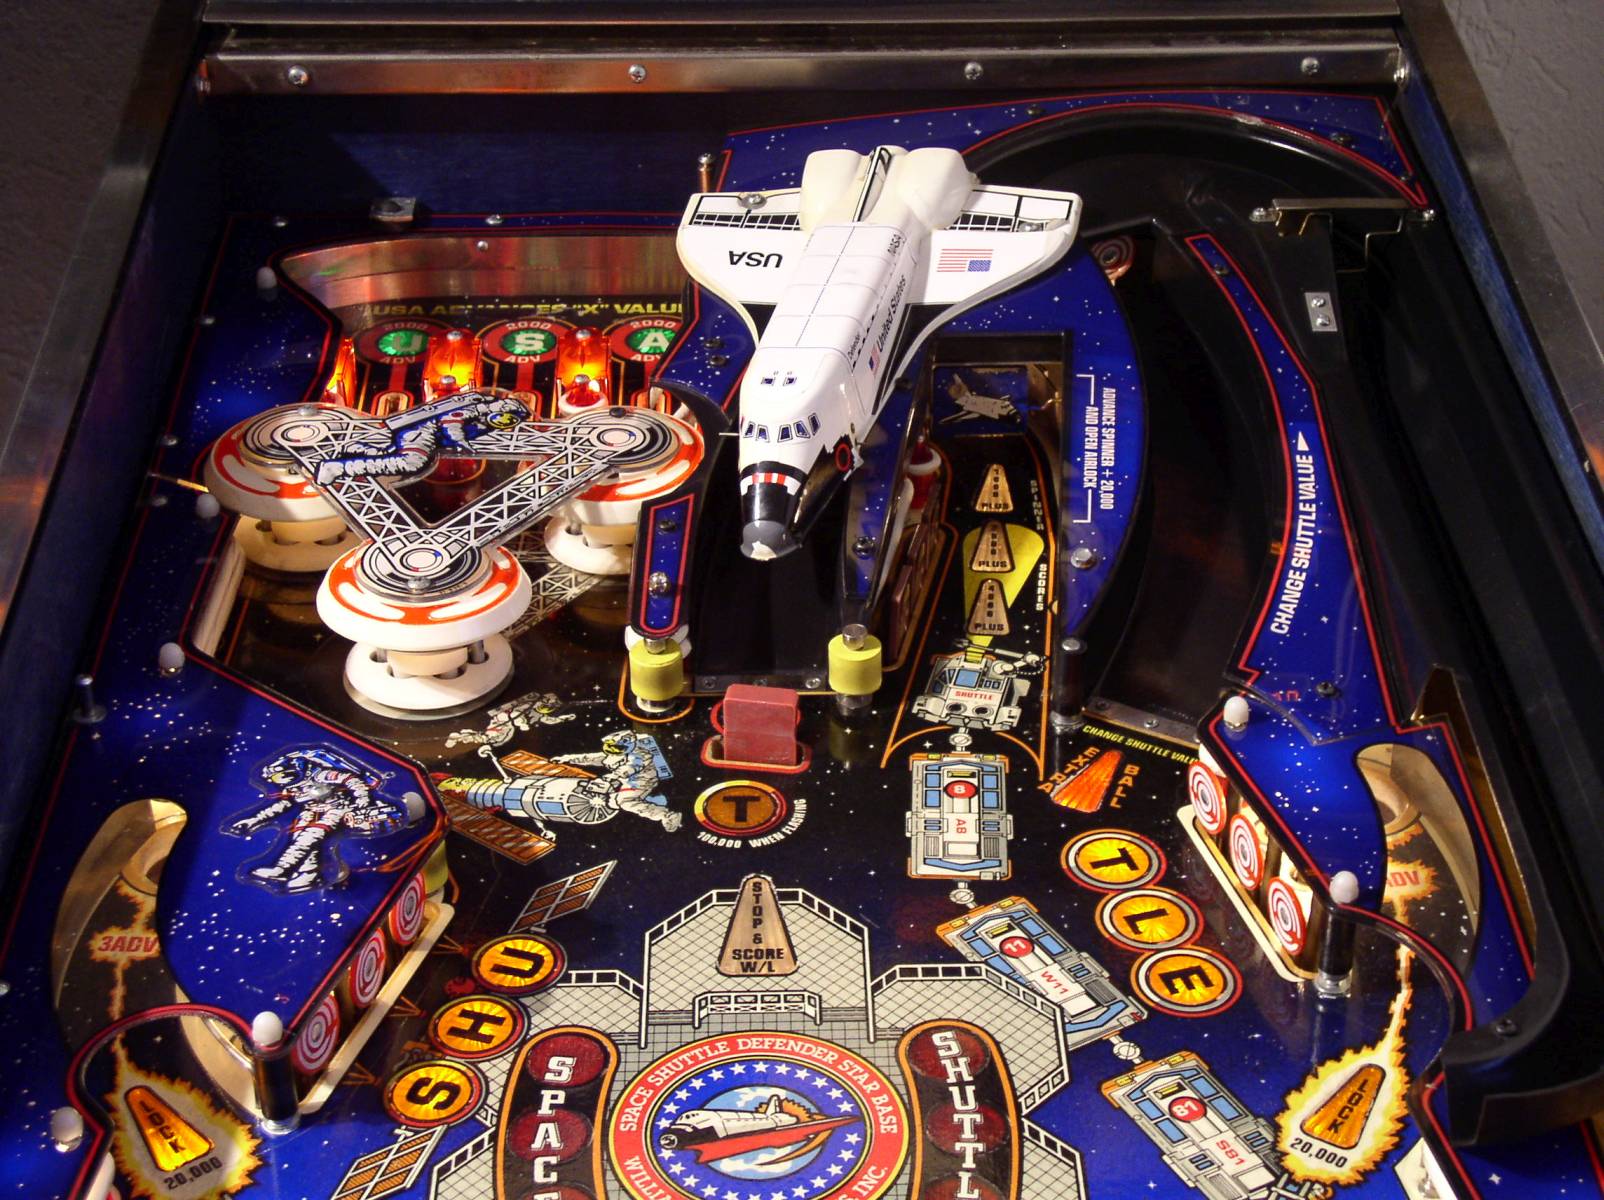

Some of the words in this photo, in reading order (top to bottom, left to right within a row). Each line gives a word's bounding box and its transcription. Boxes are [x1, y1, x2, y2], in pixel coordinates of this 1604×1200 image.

[728, 250, 783, 268] USA
[374, 305, 425, 316] USA
[629, 319, 677, 328] 2000
[505, 320, 552, 330] 2000
[877, 308, 894, 353] United
[392, 334, 423, 352] U
[514, 333, 546, 352] S
[638, 332, 671, 352] A
[379, 356, 417, 365] ADV
[503, 354, 542, 364] ADV
[1085, 406, 1099, 425] AND
[1102, 387, 1116, 426] ADVANCE
[1084, 426, 1098, 450] OPEN
[1101, 427, 1115, 467] SPINNER
[1083, 451, 1098, 488] AIRLOCK
[1296, 454, 1317, 502] VALUE
[981, 502, 1009, 510] PLUS
[1099, 479, 1114, 510] 20,000
[1291, 502, 1316, 569] SHUTTLE
[978, 560, 1008, 569] PLUS
[1270, 569, 1307, 635] CHANGE
[974, 623, 1005, 632] PLUS
[954, 690, 994, 701] SHUTTLE
[1082, 725, 1126, 745] CHANGE
[1125, 738, 1170, 758] SHUTTLE
[1037, 746, 1100, 794] EXTRA
[1109, 764, 1140, 809] BALL
[722, 795, 761, 823] T
[697, 830, 742, 849] 100,000
[749, 831, 786, 849] WHEN
[782, 798, 807, 835] FLASHING
[1089, 847, 1139, 872] T
[751, 881, 764, 930] STOP
[1122, 907, 1169, 936] L
[98, 935, 158, 953] 3ADV
[752, 932, 764, 945] &
[1004, 939, 1027, 953] 11
[489, 946, 545, 979] U
[732, 947, 785, 961] SCORE
[740, 960, 776, 974] W/L
[1041, 970, 1069, 995] W11
[1158, 964, 1215, 996] E
[446, 1008, 506, 1045] H
[406, 1076, 462, 1111] S
[619, 1086, 655, 1132] SPACE
[647, 1041, 731, 1087] SHUTTLE
[737, 1037, 839, 1065] DEFENDER
[837, 1059, 881, 1095] STAR
[871, 1093, 898, 1134] BASE
[1171, 1100, 1199, 1117] 81
[1327, 1078, 1369, 1134] LOCK
[138, 1100, 187, 1154] LOCK
[1216, 1139, 1246, 1166] S81
[1289, 1136, 1349, 1169] 20,000
[163, 1155, 224, 1191] 20,000
[624, 1155, 673, 1200] WILLI
[852, 1165, 889, 1197] INC.
